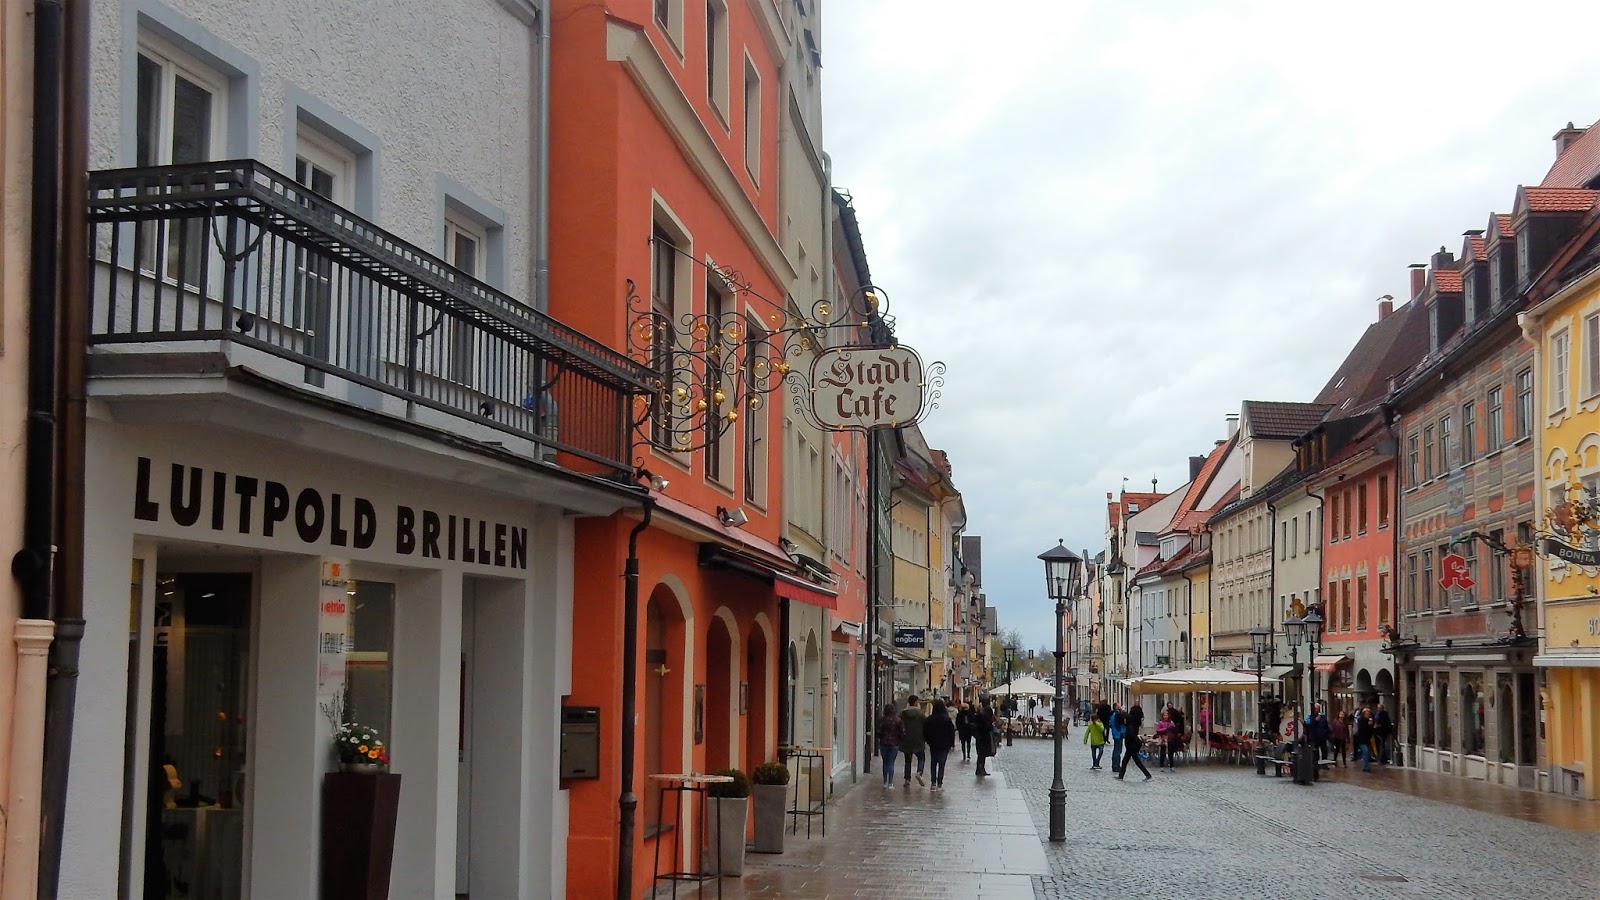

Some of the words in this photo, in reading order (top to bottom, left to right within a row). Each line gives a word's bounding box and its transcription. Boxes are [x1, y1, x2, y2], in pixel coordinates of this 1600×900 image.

[818, 352, 912, 388] Stadt
[134, 456, 377, 549] LUITPOLD
[396, 505, 528, 570] BRILLEN
[1559, 548, 1596, 563] BONITA
